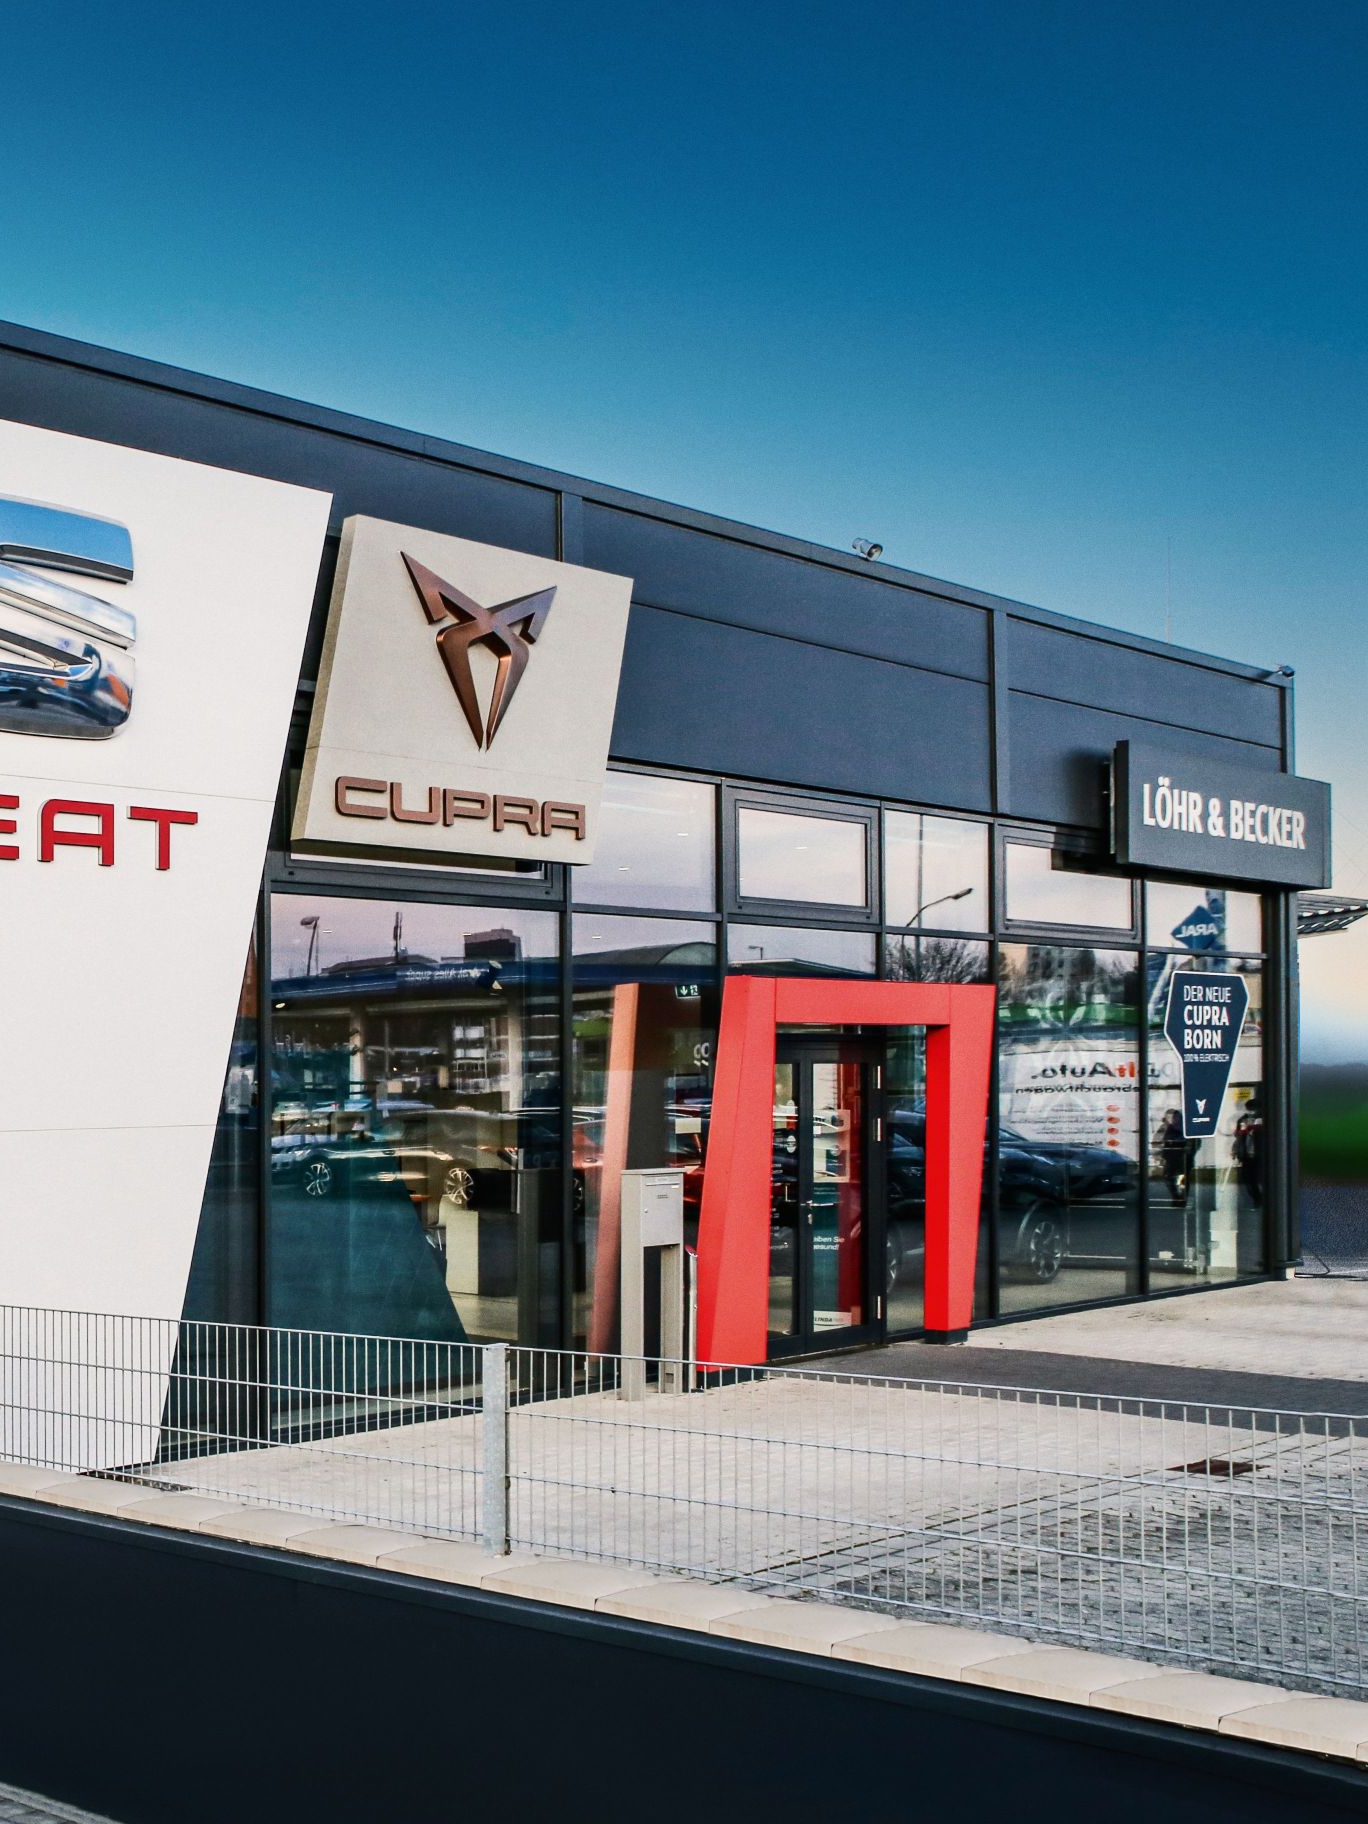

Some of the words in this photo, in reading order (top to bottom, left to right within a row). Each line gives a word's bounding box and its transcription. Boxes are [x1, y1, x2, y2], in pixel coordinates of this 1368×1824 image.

[335, 776, 586, 840] CUPRA
[1143, 776, 1204, 833] LÖHR
[1207, 797, 1226, 837] &
[1230, 799, 1306, 850] BECKER
[1183, 985, 1203, 1001] DER
[1205, 986, 1231, 1003] NEUE
[1183, 1005, 1229, 1026] CUPRA
[1184, 1029, 1221, 1050] BORN
